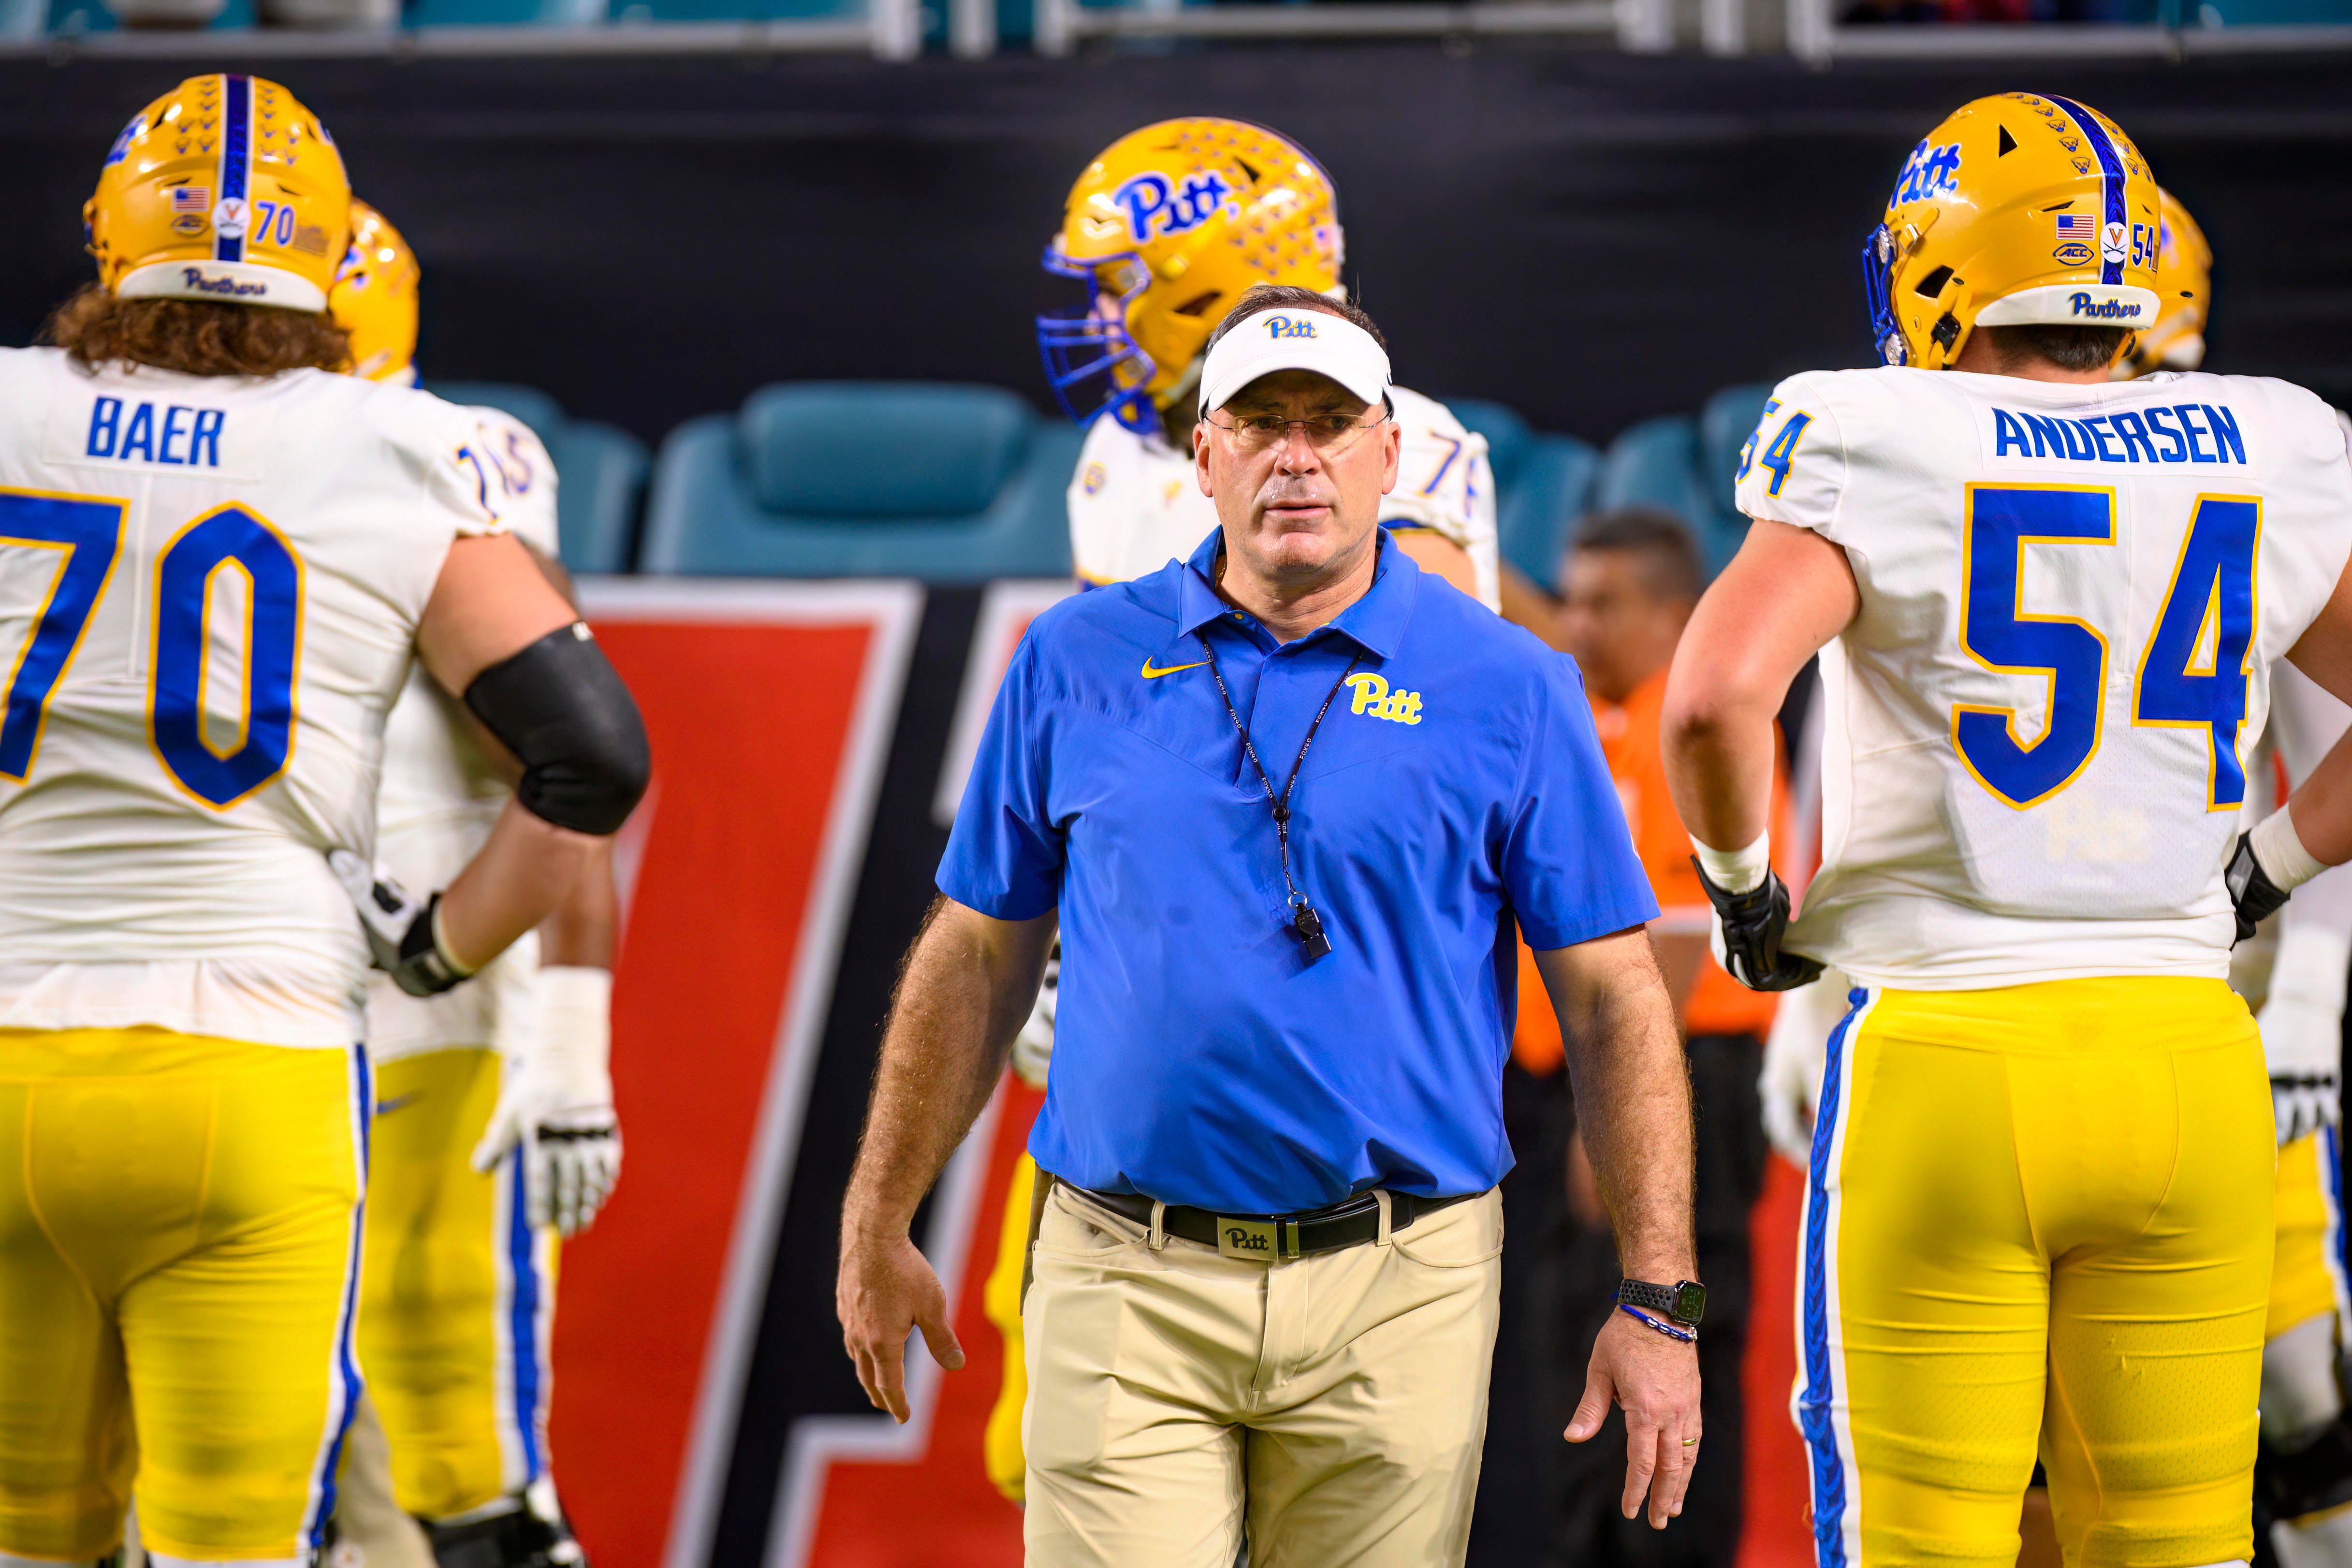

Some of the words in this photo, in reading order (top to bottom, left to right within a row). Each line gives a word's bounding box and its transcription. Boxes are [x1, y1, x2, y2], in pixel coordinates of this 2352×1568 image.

[254, 199, 295, 247] 70
[1110, 171, 1236, 246] Pitt
[2059, 248, 2088, 257] ACC
[2132, 222, 2154, 270] 54
[1262, 314, 1318, 339] Pitt
[2068, 291, 2142, 318] Panthers
[86, 396, 226, 467] BAER
[1737, 396, 1815, 500] 54
[1991, 403, 2247, 465] ANDERSEN
[0, 486, 306, 814] 70
[1950, 481, 2264, 812] 54
[1345, 673, 1423, 725] Pitt
[1225, 1228, 1269, 1250] Pitt
